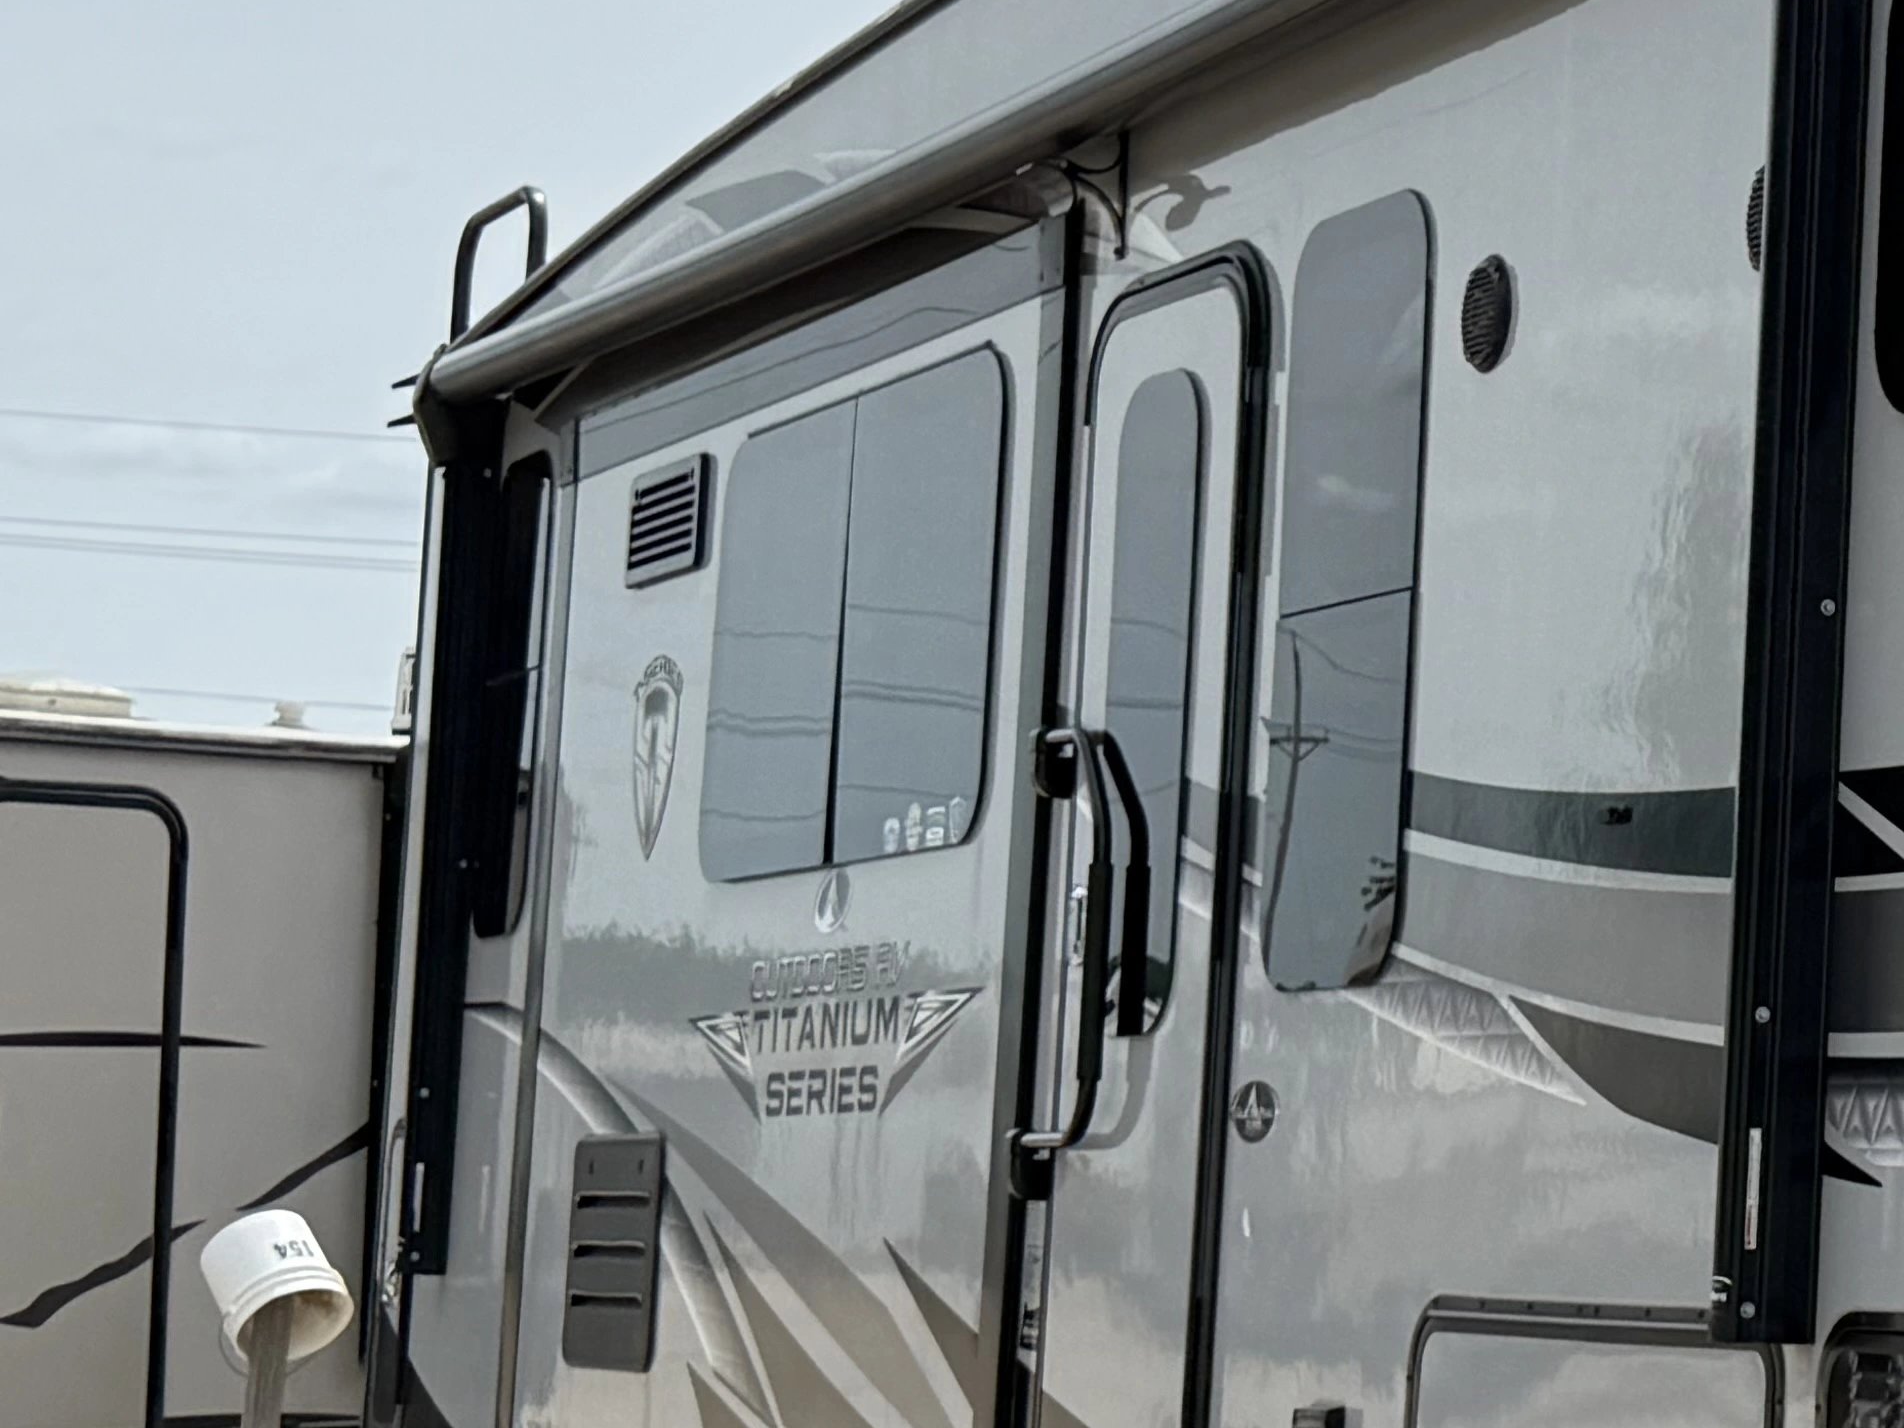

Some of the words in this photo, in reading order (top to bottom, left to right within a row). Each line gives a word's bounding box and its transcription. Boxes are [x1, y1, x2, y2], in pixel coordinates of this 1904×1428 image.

[752, 945, 870, 1003] OUTDOORS
[753, 995, 900, 1055] TITANIUM
[765, 1064, 880, 1118] SERIES
